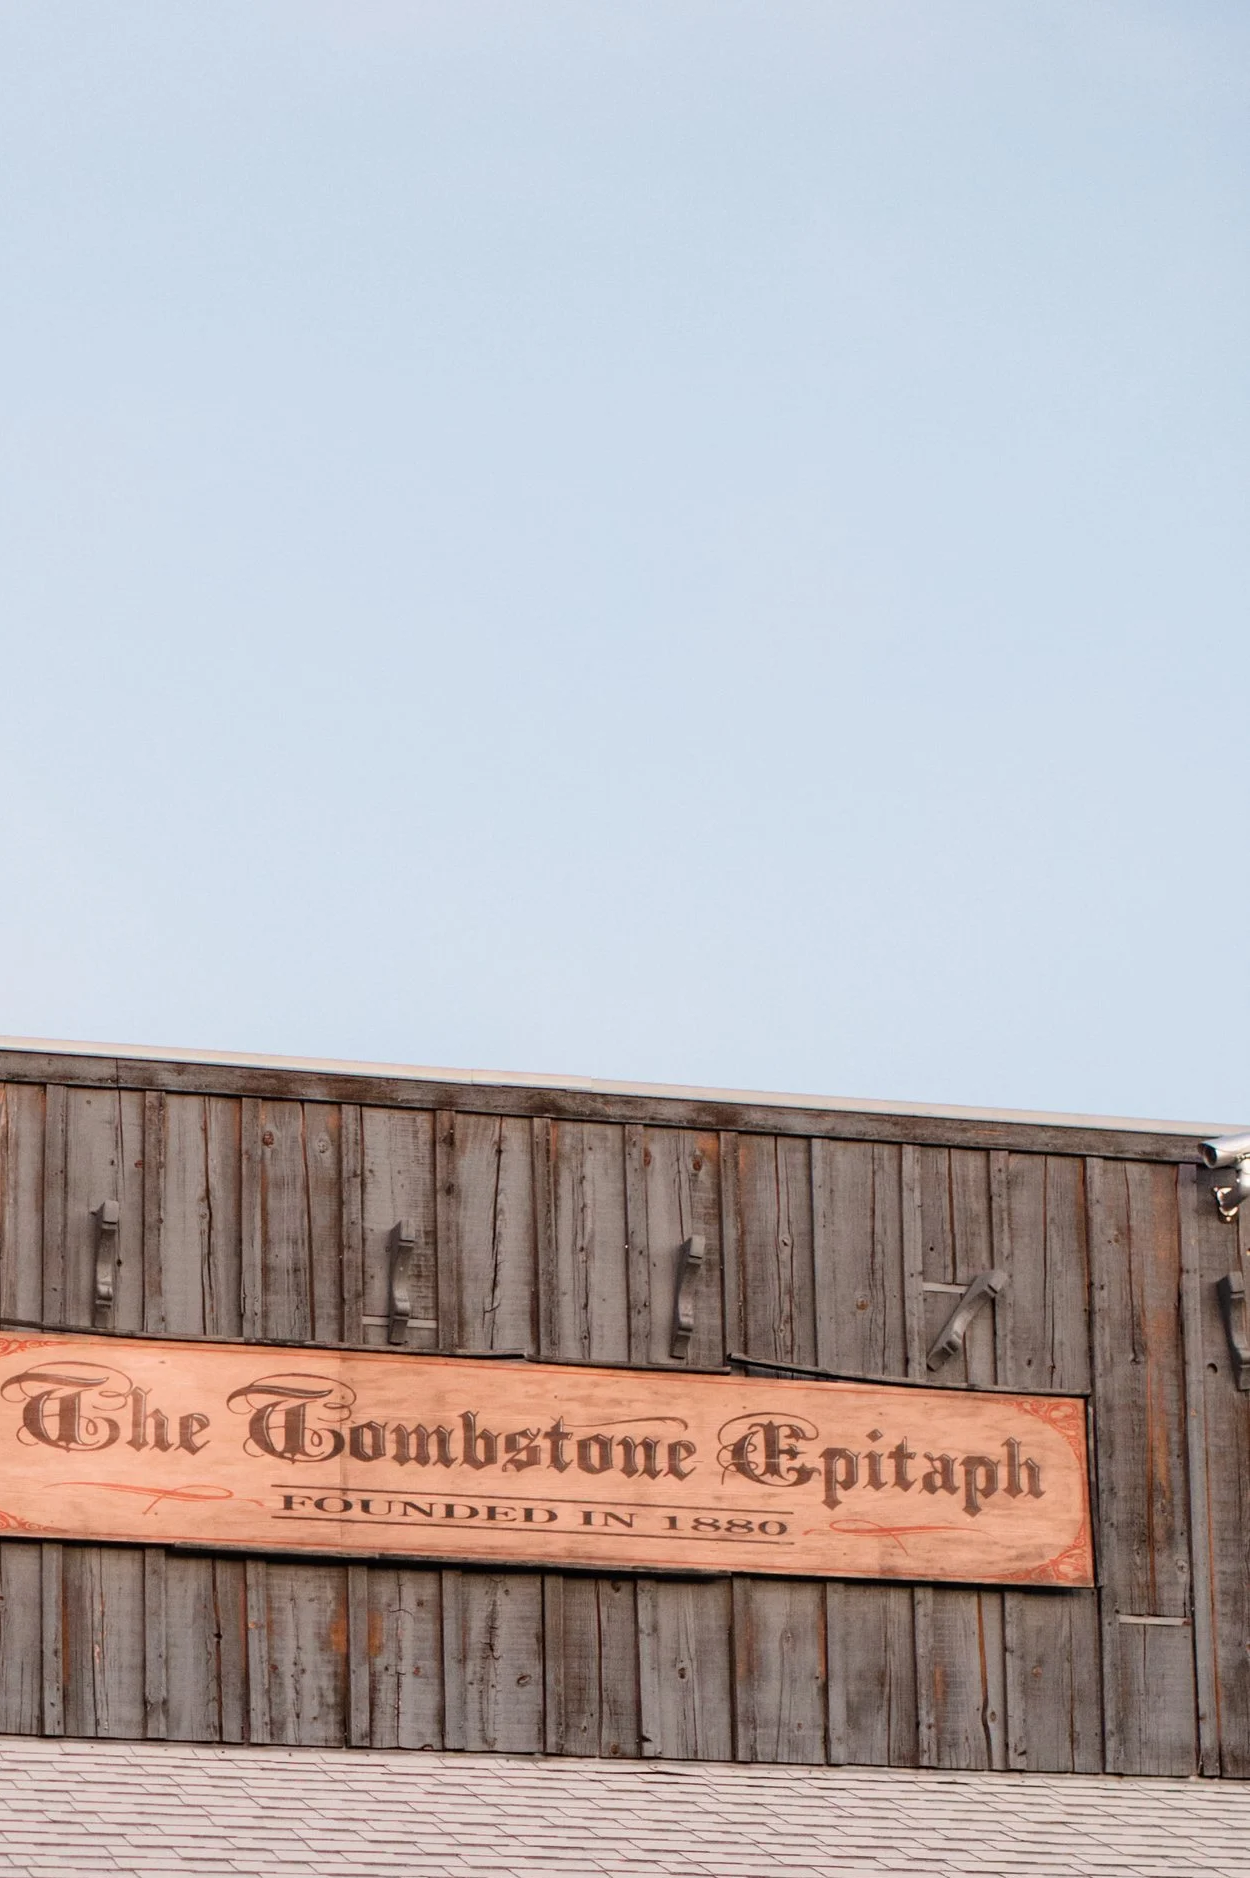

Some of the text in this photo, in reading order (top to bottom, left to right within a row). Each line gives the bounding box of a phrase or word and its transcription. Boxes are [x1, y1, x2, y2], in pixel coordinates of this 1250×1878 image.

[0, 1360, 1047, 1517] The Tombstone Epitaph
[280, 1494, 788, 1536] FOUNDED IN 1880
